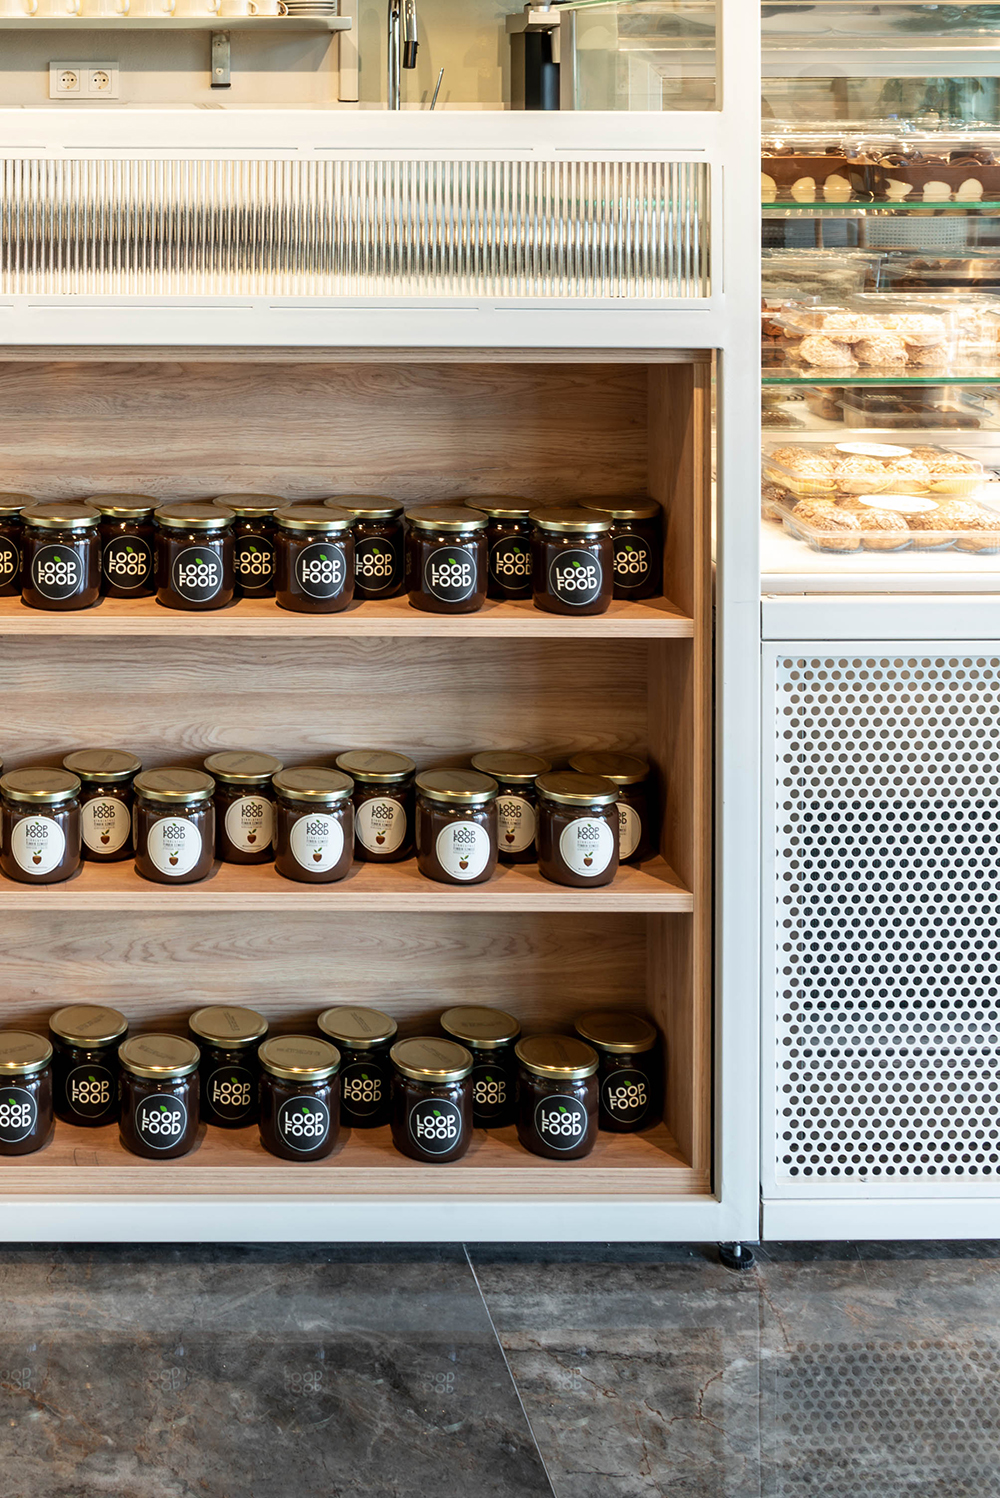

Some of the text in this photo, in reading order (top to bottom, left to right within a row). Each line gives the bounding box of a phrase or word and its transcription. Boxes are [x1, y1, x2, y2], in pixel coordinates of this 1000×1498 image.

[109, 551, 146, 564] LOOP
[356, 554, 392, 565] LOOP
[38, 561, 76, 574] LOOP
[108, 562, 146, 575] FOOD
[179, 564, 217, 576] LOOP
[303, 560, 341, 572] LOOP
[356, 564, 392, 576] FOOD
[432, 564, 471, 576] LOOP
[38, 572, 77, 585] FOOD
[302, 571, 341, 583] FOOD
[556, 566, 596, 580] LOOP
[179, 575, 218, 587] FOOD
[432, 575, 471, 587] FOOD
[557, 577, 597, 591] FOOD
[93, 811, 115, 819] FOOD
[372, 805, 393, 813] LOOP
[372, 812, 393, 820] FOOD
[453, 836, 476, 844] FOOD
[72, 1080, 109, 1093] LOOP
[214, 1081, 250, 1095] LOOP
[344, 1077, 381, 1091] LOOP
[473, 1081, 506, 1093] OOP
[72, 1091, 110, 1104] FOOD
[344, 1089, 382, 1102] FOOD
[608, 1083, 645, 1099] LOOP
[213, 1092, 250, 1106] FOOD
[473, 1092, 506, 1104] OOD
[610, 1093, 647, 1110] FOOD
[142, 1109, 181, 1123] LOOP
[285, 1112, 324, 1125] LOOP
[416, 1114, 456, 1128] LOOP
[542, 1109, 581, 1124] LOOP
[142, 1120, 181, 1135] FOOD
[285, 1123, 324, 1137] FOOD
[417, 1126, 457, 1139] FOOD
[542, 1121, 582, 1136] FOOD
